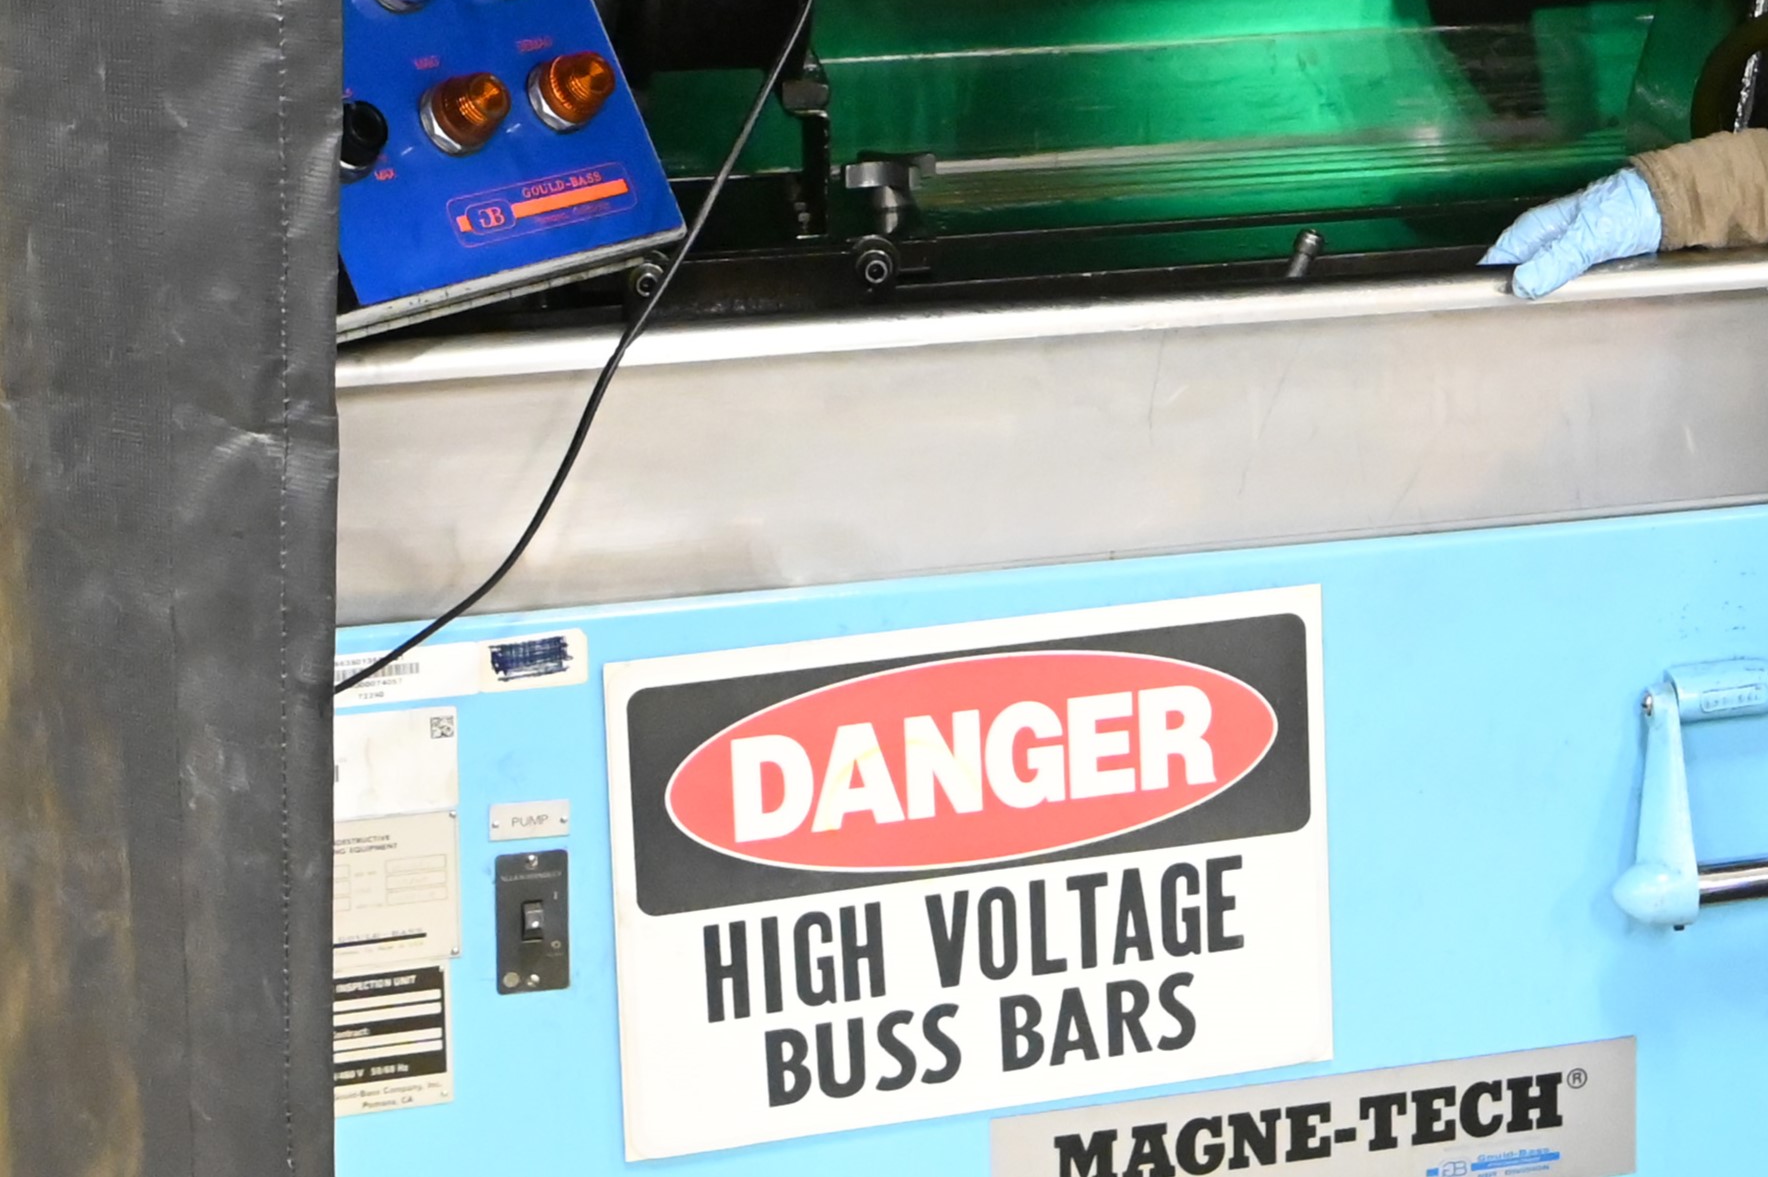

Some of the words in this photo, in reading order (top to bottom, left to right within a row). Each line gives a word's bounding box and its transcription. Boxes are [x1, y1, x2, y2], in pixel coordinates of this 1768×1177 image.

[521, 171, 603, 199] GOULD-BASS
[730, 685, 1217, 844] DANGER
[511, 814, 549, 827] PUMP
[703, 901, 887, 1024] HIGH
[925, 854, 1245, 988] VOLTAGE
[393, 974, 417, 987] UNIT
[764, 1003, 962, 1108] BUSS
[1000, 971, 1198, 1073] BARS
[401, 1095, 413, 1104] CA
